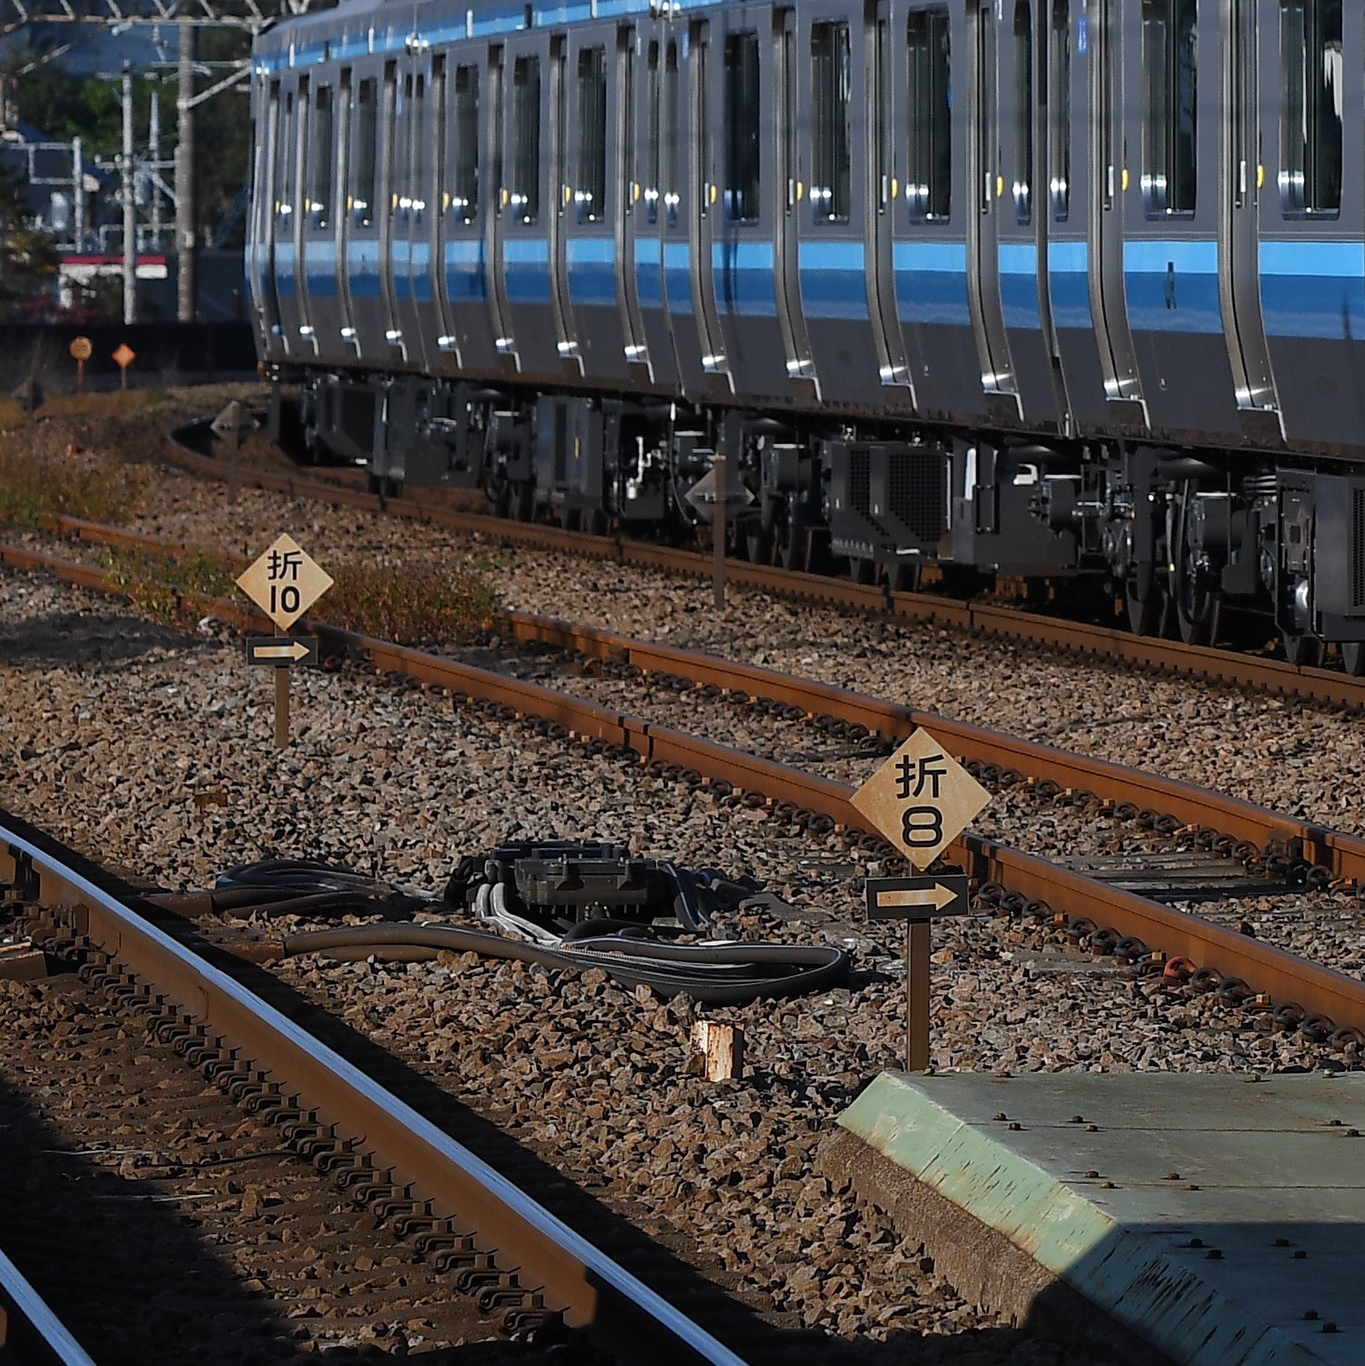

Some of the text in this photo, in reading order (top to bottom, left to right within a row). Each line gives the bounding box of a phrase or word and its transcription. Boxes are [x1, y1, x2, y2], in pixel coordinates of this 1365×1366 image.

[267, 549, 303, 581] 折
[270, 585, 301, 614] 10
[895, 754, 947, 799] 折
[902, 805, 944, 848] 8
